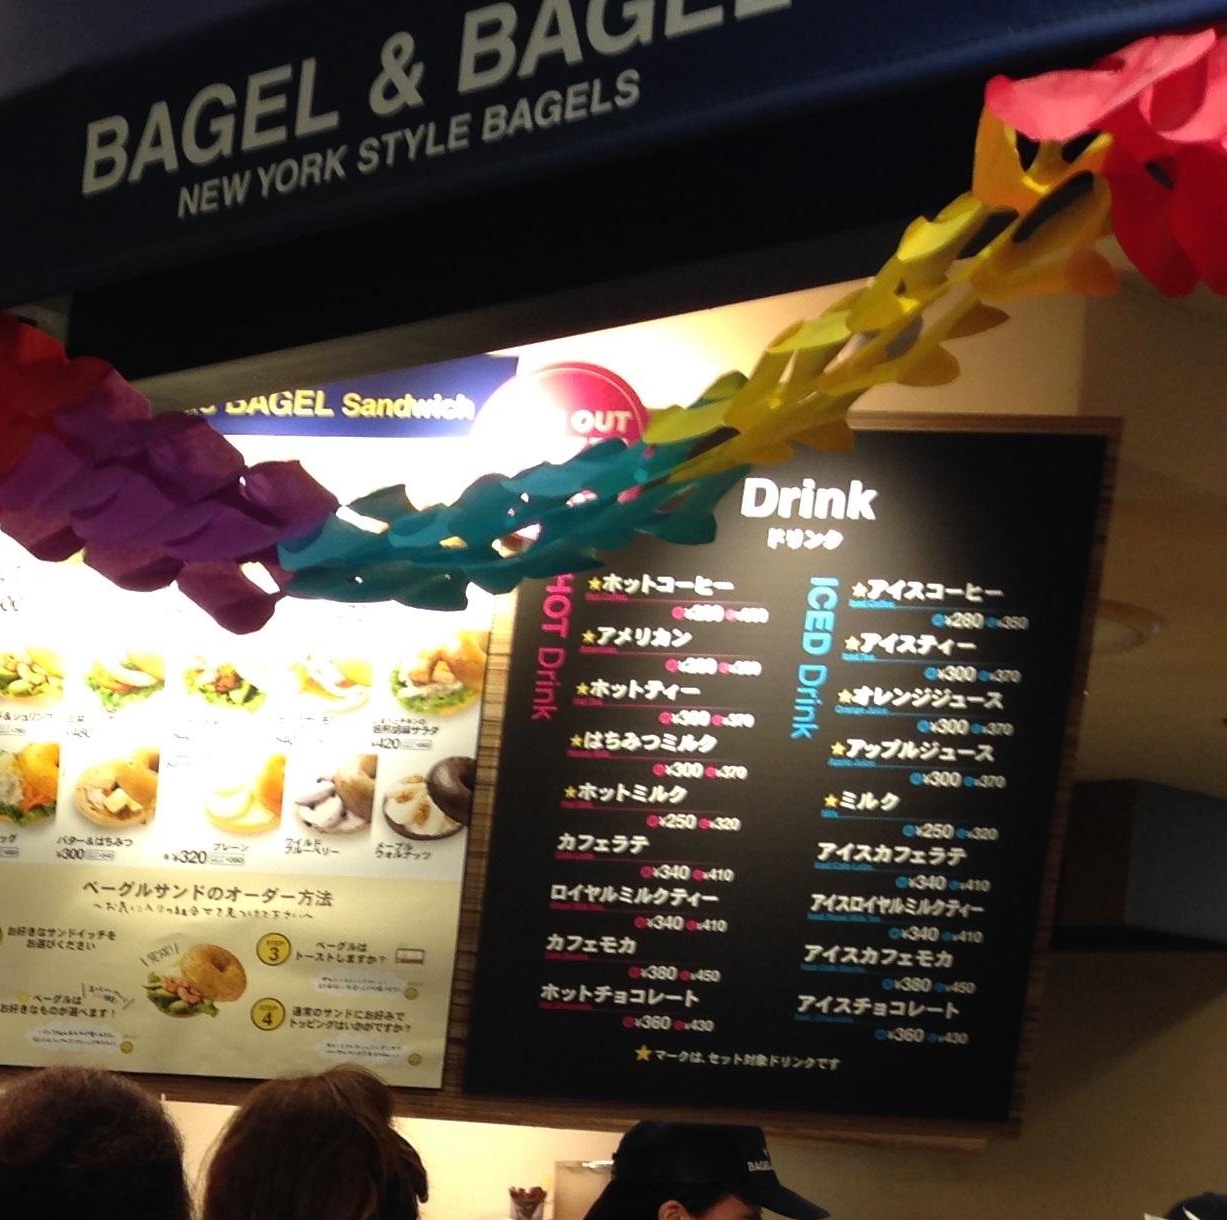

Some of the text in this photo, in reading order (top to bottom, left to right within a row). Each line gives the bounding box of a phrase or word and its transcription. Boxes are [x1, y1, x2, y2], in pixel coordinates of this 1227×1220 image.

[81, 0, 792, 198] BAGEL & BAGE
[177, 69, 641, 220] NEW YORK STYLE BAGELS
[343, 392, 475, 421] Sandwich
[740, 476, 877, 521] Drink
[767, 527, 843, 551] ドリンク
[602, 574, 734, 596] ホットコーヒー
[868, 579, 1004, 603] アイスコーヒー
[531, 573, 574, 721] HOT Drink
[597, 626, 692, 648] アメリカン
[860, 632, 977, 656] アイスティー
[790, 577, 840, 739] ICED Drink
[590, 679, 701, 700] ホットティー
[852, 686, 1004, 710] オレンジジュース
[584, 731, 717, 753] はちみつミルク
[846, 738, 995, 762] アップルジュース
[578, 782, 688, 803] ホットミルク
[840, 790, 900, 811] ミルク
[557, 833, 650, 854] カフェラテ
[818, 842, 967, 866] アイスカフェラテ
[82, 880, 333, 907] ベーグルサンドのオーダー方法
[550, 884, 720, 908] ロイヤルミルクティー
[810, 893, 985, 918] アイスロイヤルミルクティー
[7, 926, 116, 942] お好きなサンドイッチを
[546, 934, 637, 955] カフェモカ
[268, 946, 279, 962] 3
[316, 941, 368, 953] ベーグルは
[804, 944, 954, 969] アイスカフェモカ
[540, 984, 700, 1007] ホットチョコレート
[797, 995, 960, 1020] アイスチョコレート
[261, 1011, 273, 1027] 4
